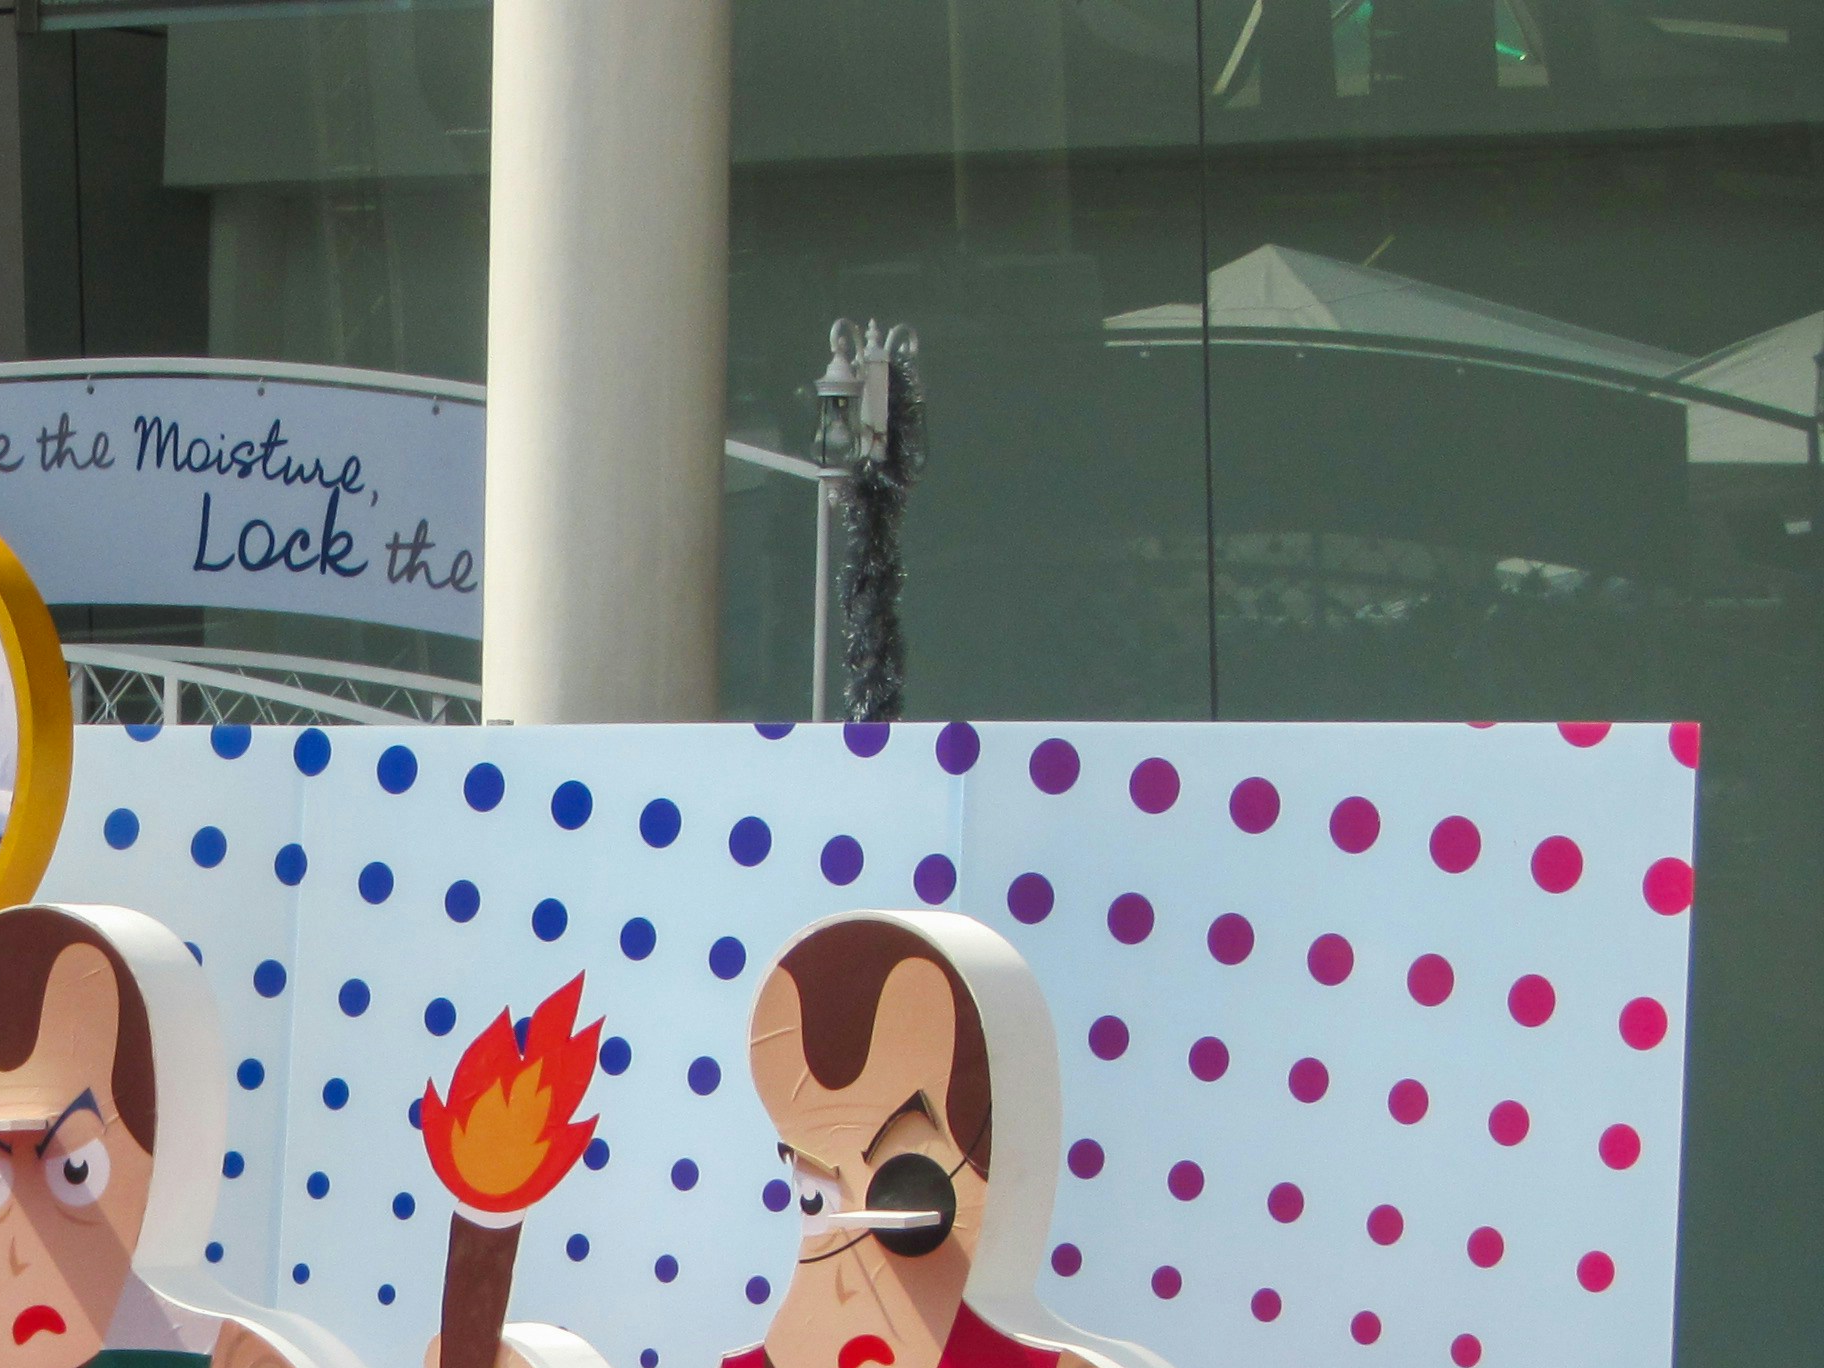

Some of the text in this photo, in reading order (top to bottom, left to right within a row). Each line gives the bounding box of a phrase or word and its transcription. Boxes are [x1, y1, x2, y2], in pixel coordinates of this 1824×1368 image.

[36, 412, 115, 471] the
[134, 415, 378, 507] Moisture,
[193, 486, 478, 593] Lock the
